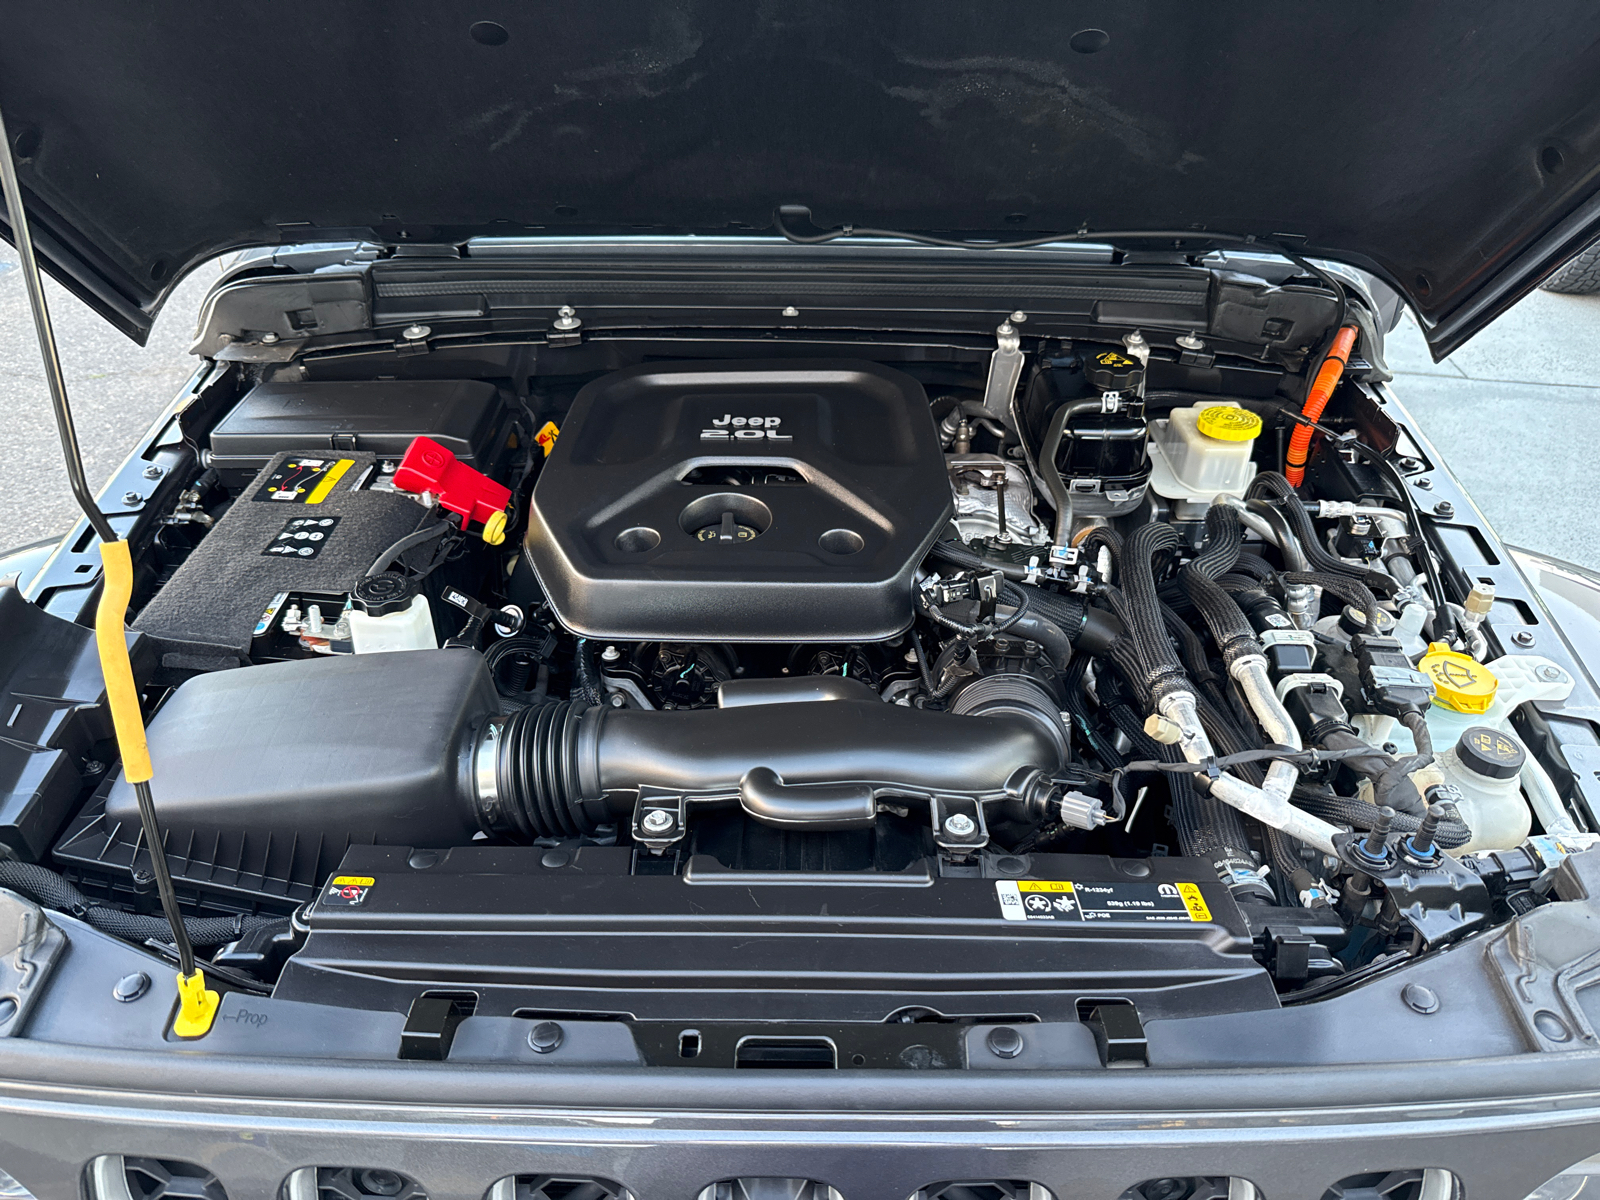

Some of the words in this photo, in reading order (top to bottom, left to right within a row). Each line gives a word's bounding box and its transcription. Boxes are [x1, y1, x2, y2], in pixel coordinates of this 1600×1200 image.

[712, 414, 781, 428] Jeep
[700, 429, 793, 441] 2.0L
[236, 1008, 268, 1028] Prop
